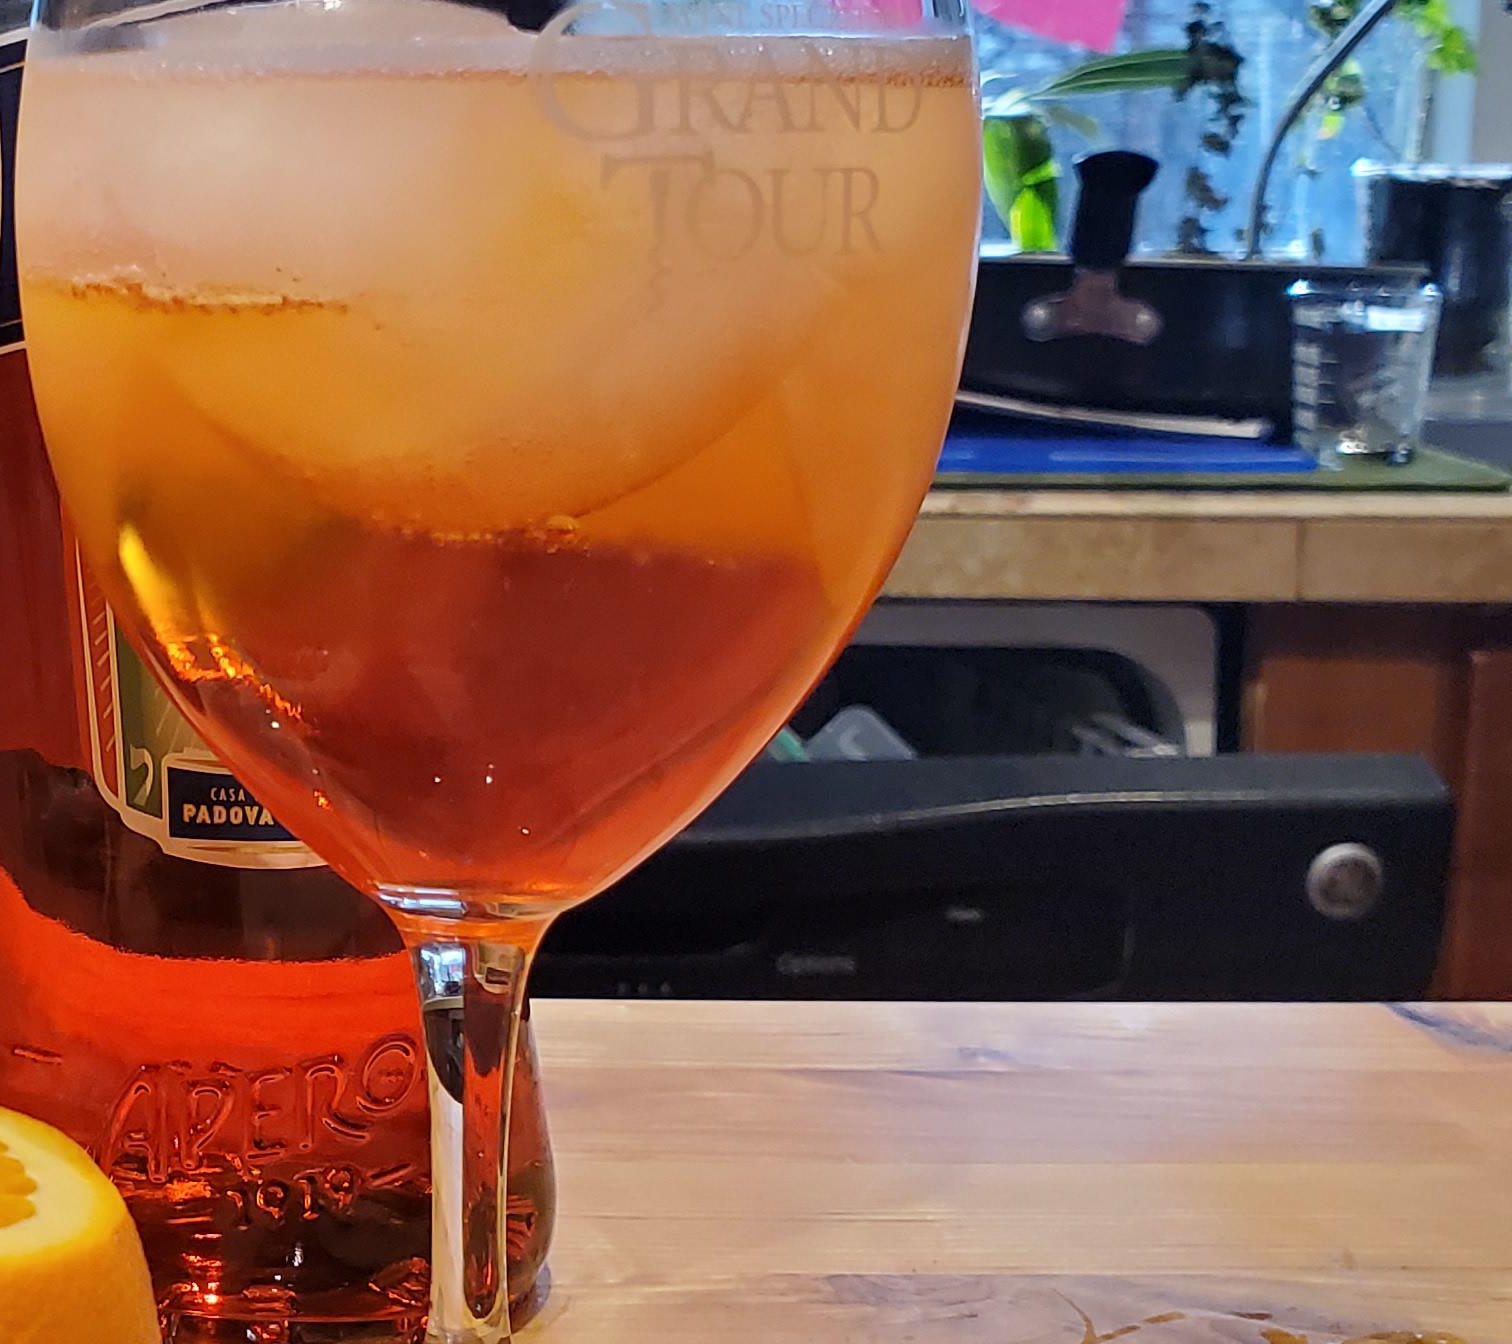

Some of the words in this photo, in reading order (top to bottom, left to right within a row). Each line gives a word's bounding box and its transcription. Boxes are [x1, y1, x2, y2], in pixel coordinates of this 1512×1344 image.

[599, 151, 885, 261] TOUR
[182, 803, 275, 826] PADOVA
[210, 787, 246, 802] CASA
[103, 1034, 420, 1184] APERO
